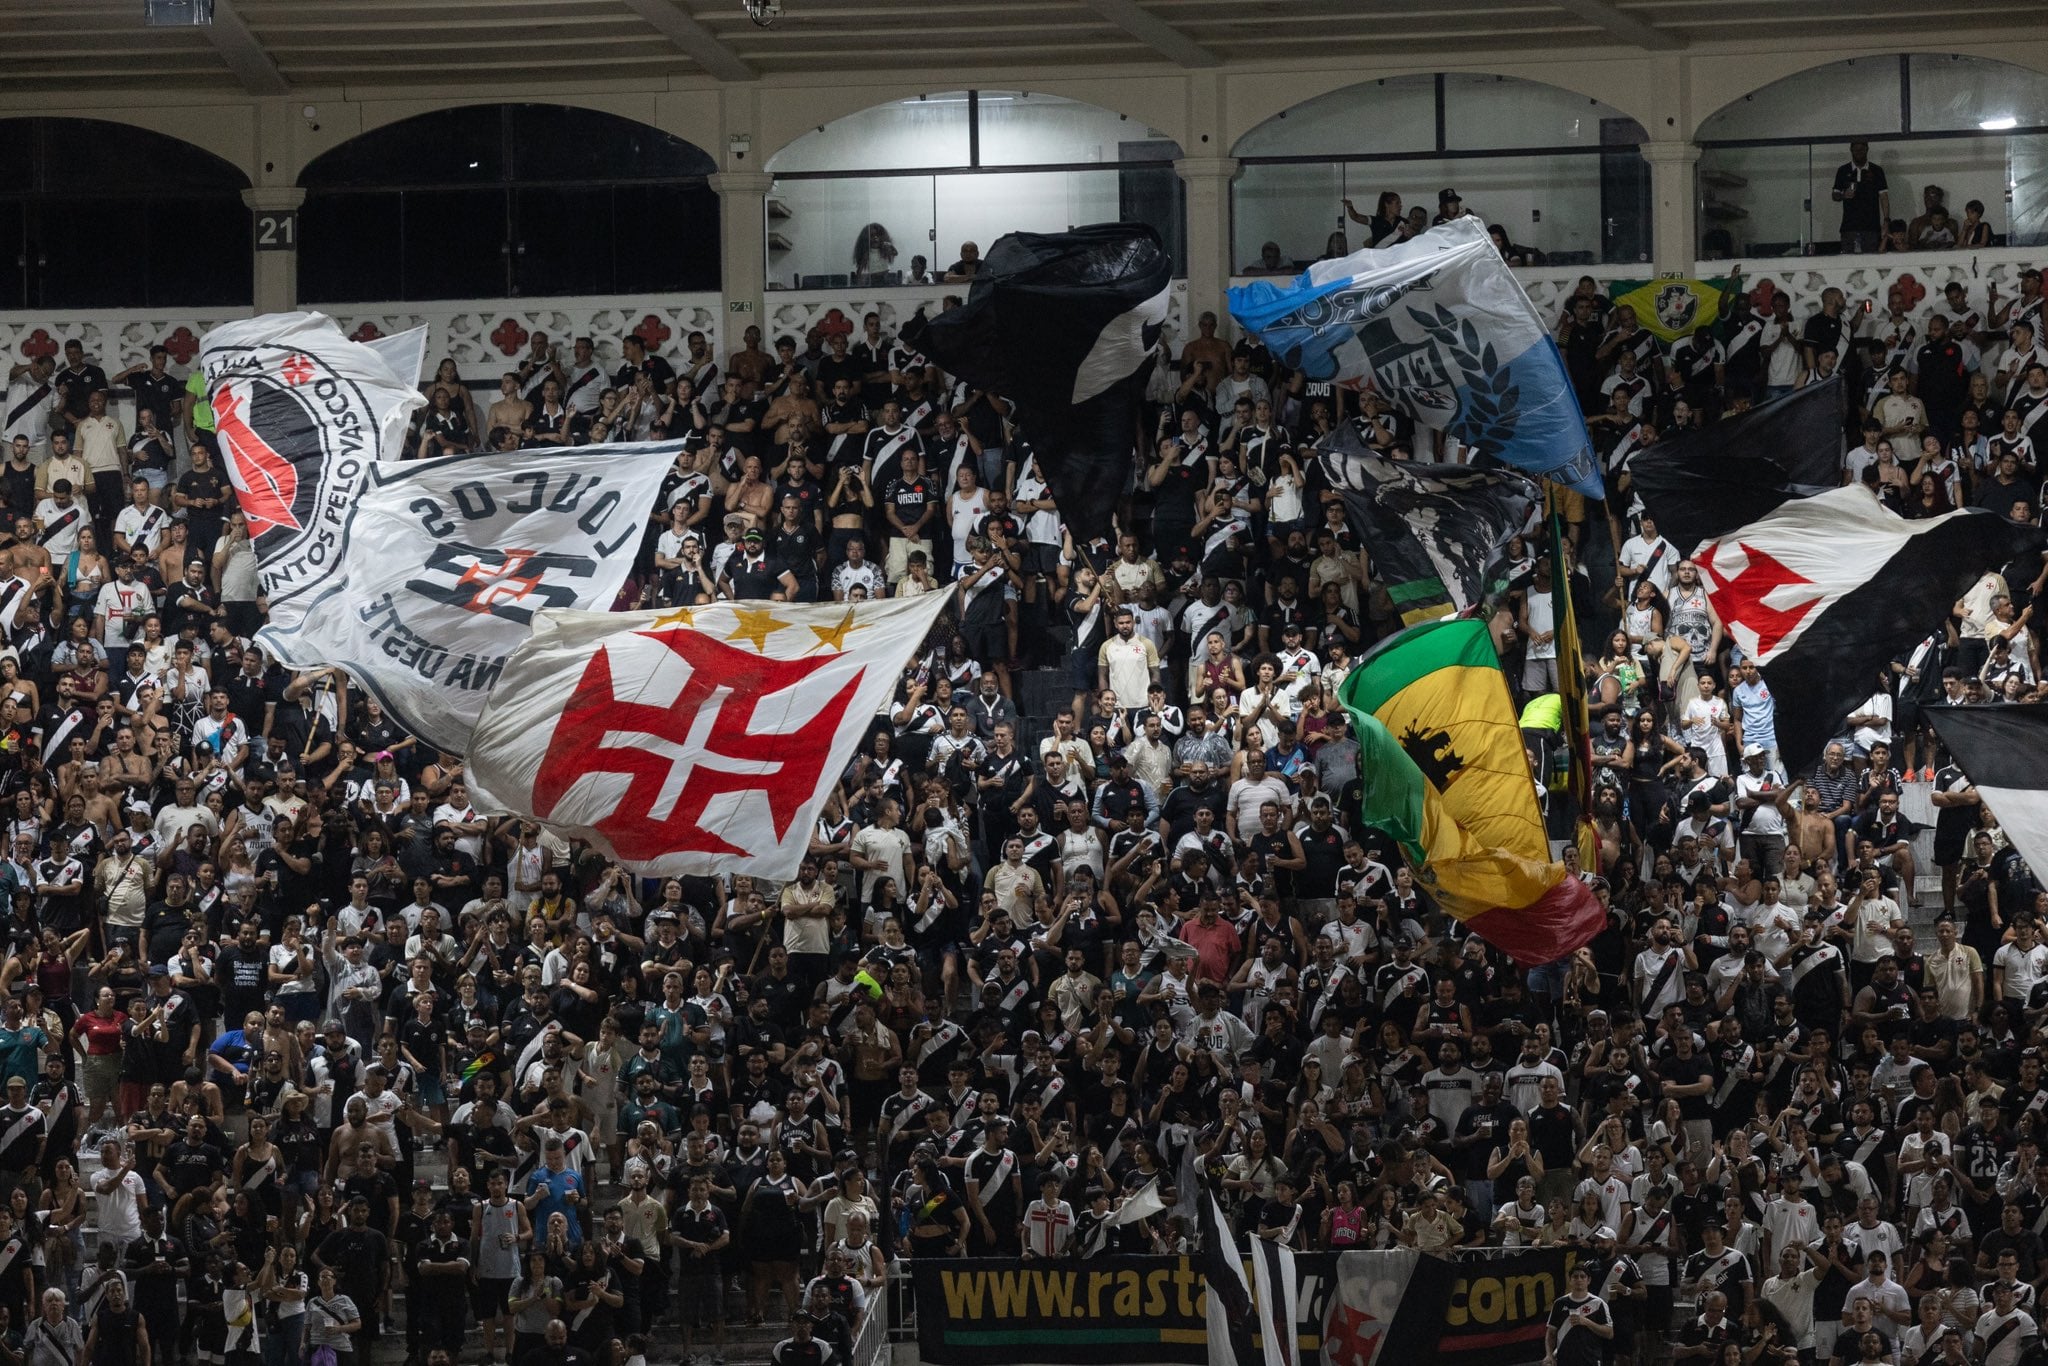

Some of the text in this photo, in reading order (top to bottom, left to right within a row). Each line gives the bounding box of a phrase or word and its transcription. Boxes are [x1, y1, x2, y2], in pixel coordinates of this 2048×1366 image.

[258, 217, 294, 245] 21
[314, 377, 365, 459] VASCO
[325, 460, 361, 525] PELO
[897, 492, 924, 504] VASCO
